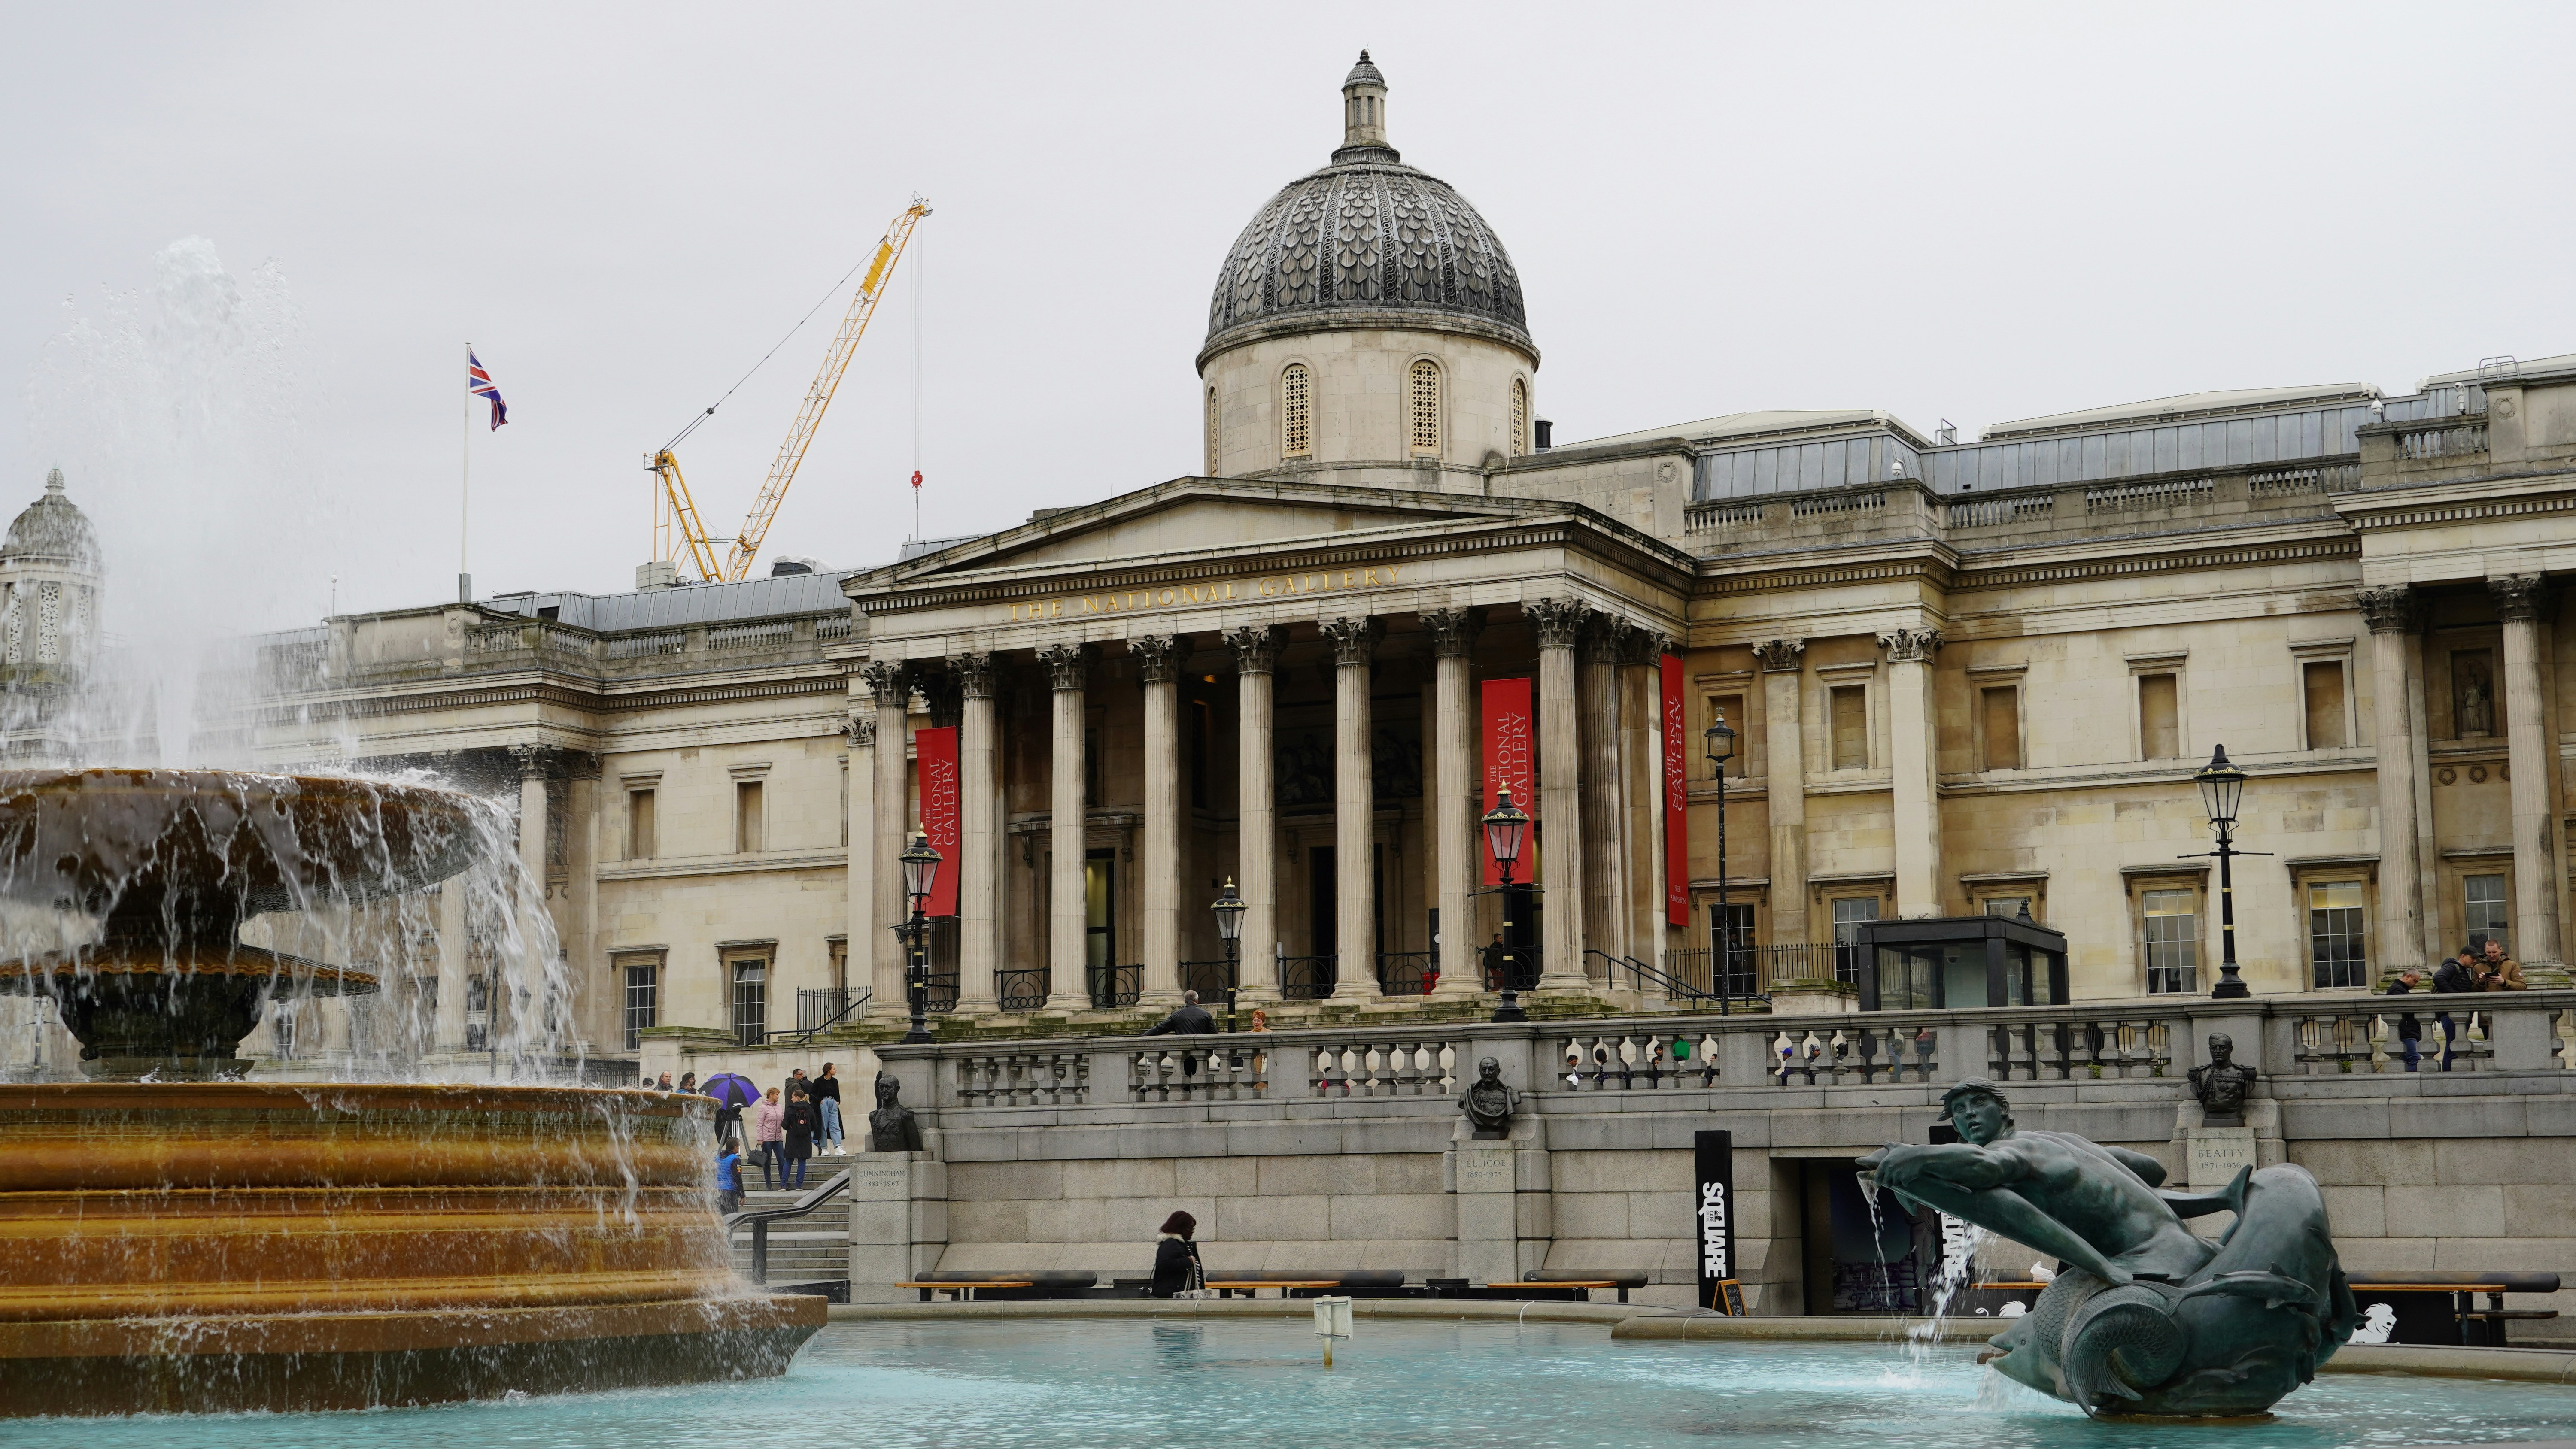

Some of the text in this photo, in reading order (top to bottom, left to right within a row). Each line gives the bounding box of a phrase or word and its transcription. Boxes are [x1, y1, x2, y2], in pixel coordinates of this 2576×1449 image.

[1007, 565, 1403, 621] THE NATIONAL GALLERY
[1498, 712, 1511, 797] ATIONAL
[1512, 712, 1528, 807] GALLERY
[1669, 694, 1677, 808] NATIONAL
[930, 758, 942, 846] NATIONAL
[942, 758, 955, 846] GALLERY
[1461, 1159, 1506, 1168] JELLICOE
[2198, 1149, 2245, 1158] BEATTY
[1698, 1182, 1726, 1278] SQUARE
[1935, 1210, 1967, 1278] UARE
